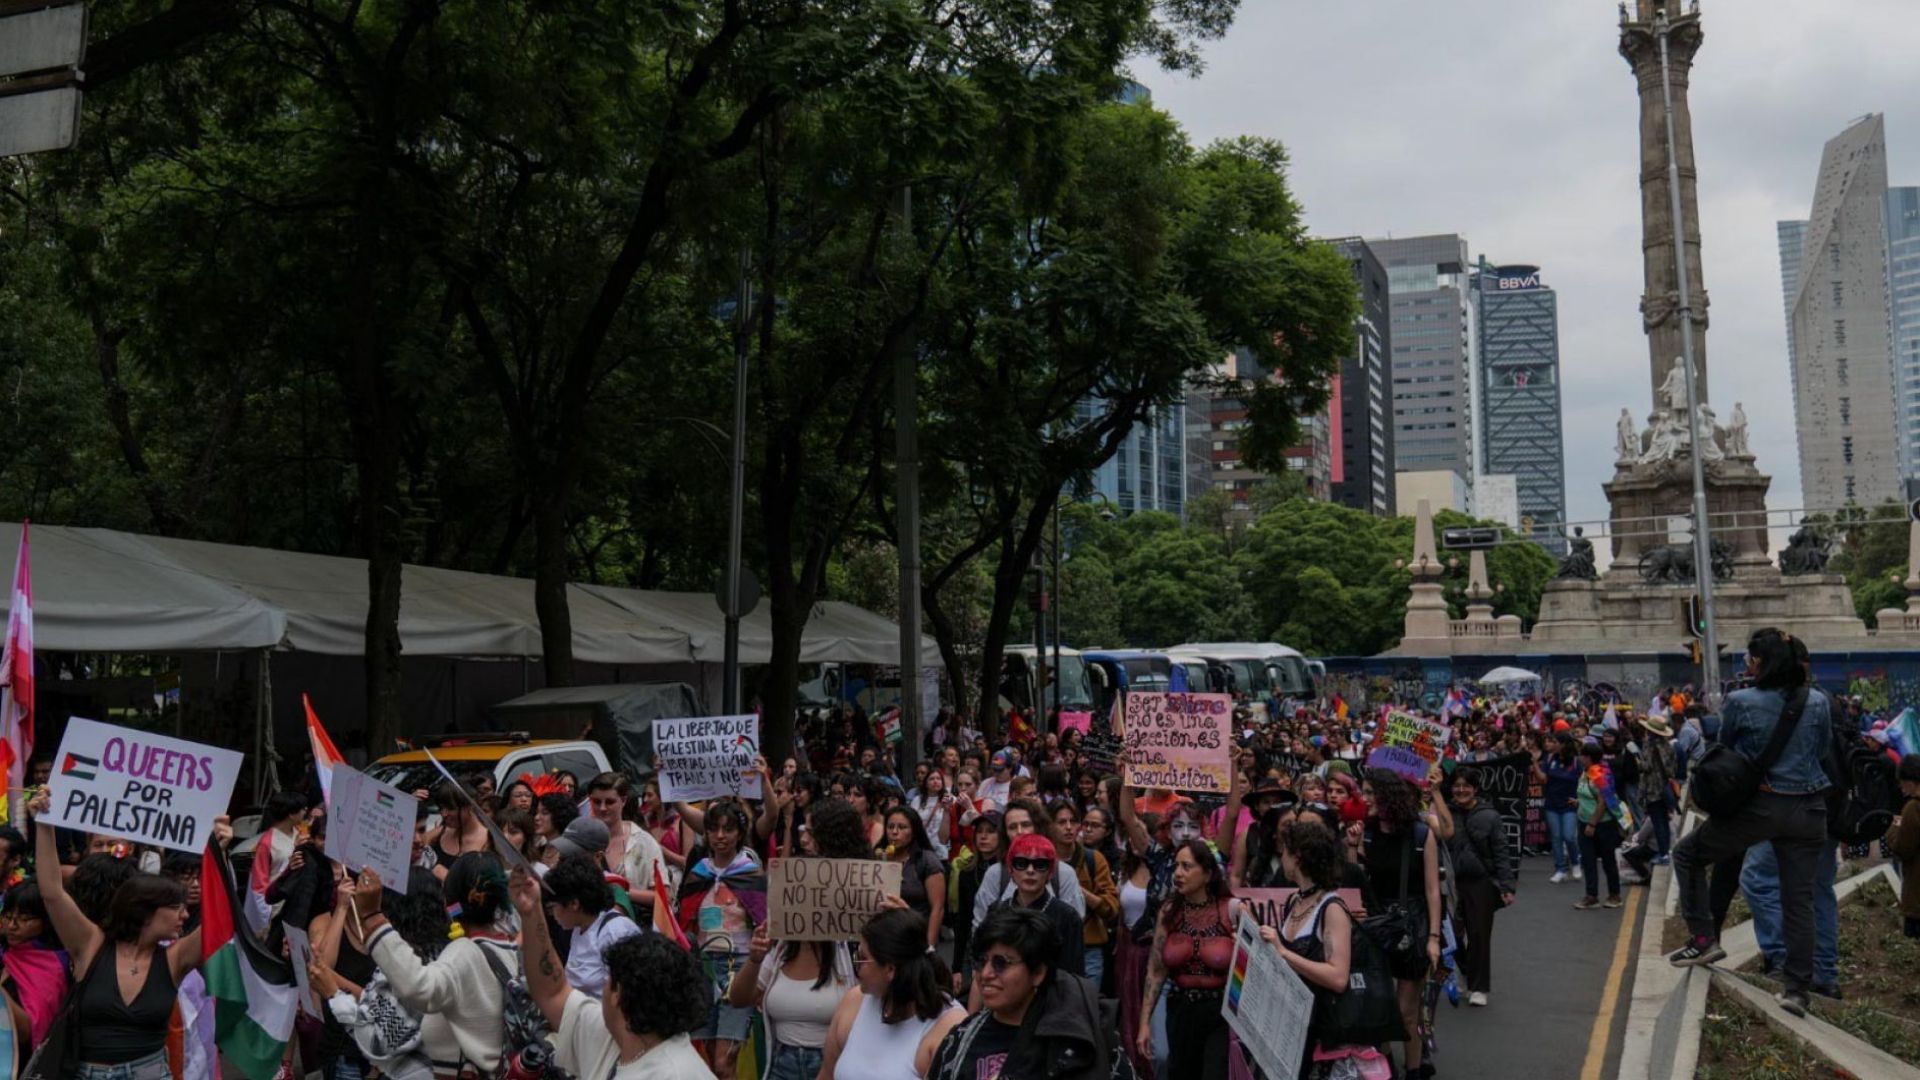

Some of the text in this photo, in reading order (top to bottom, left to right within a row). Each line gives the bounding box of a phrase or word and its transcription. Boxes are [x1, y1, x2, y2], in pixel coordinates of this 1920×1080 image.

[1499, 276, 1538, 289] BBVA
[657, 719, 753, 740] LA LIBERTAD DE
[1155, 712, 1176, 729] es
[1180, 713, 1218, 730] una
[658, 739, 738, 757] PALESTINA ES
[102, 737, 214, 791] QUEERS
[666, 771, 707, 788] TRANS
[709, 771, 716, 782] Y
[123, 780, 173, 807] POR
[63, 789, 196, 846] PALESTINA
[784, 860, 884, 888] LO QUEER
[782, 885, 886, 912] NO TE QUITA
[784, 912, 806, 935] LO
